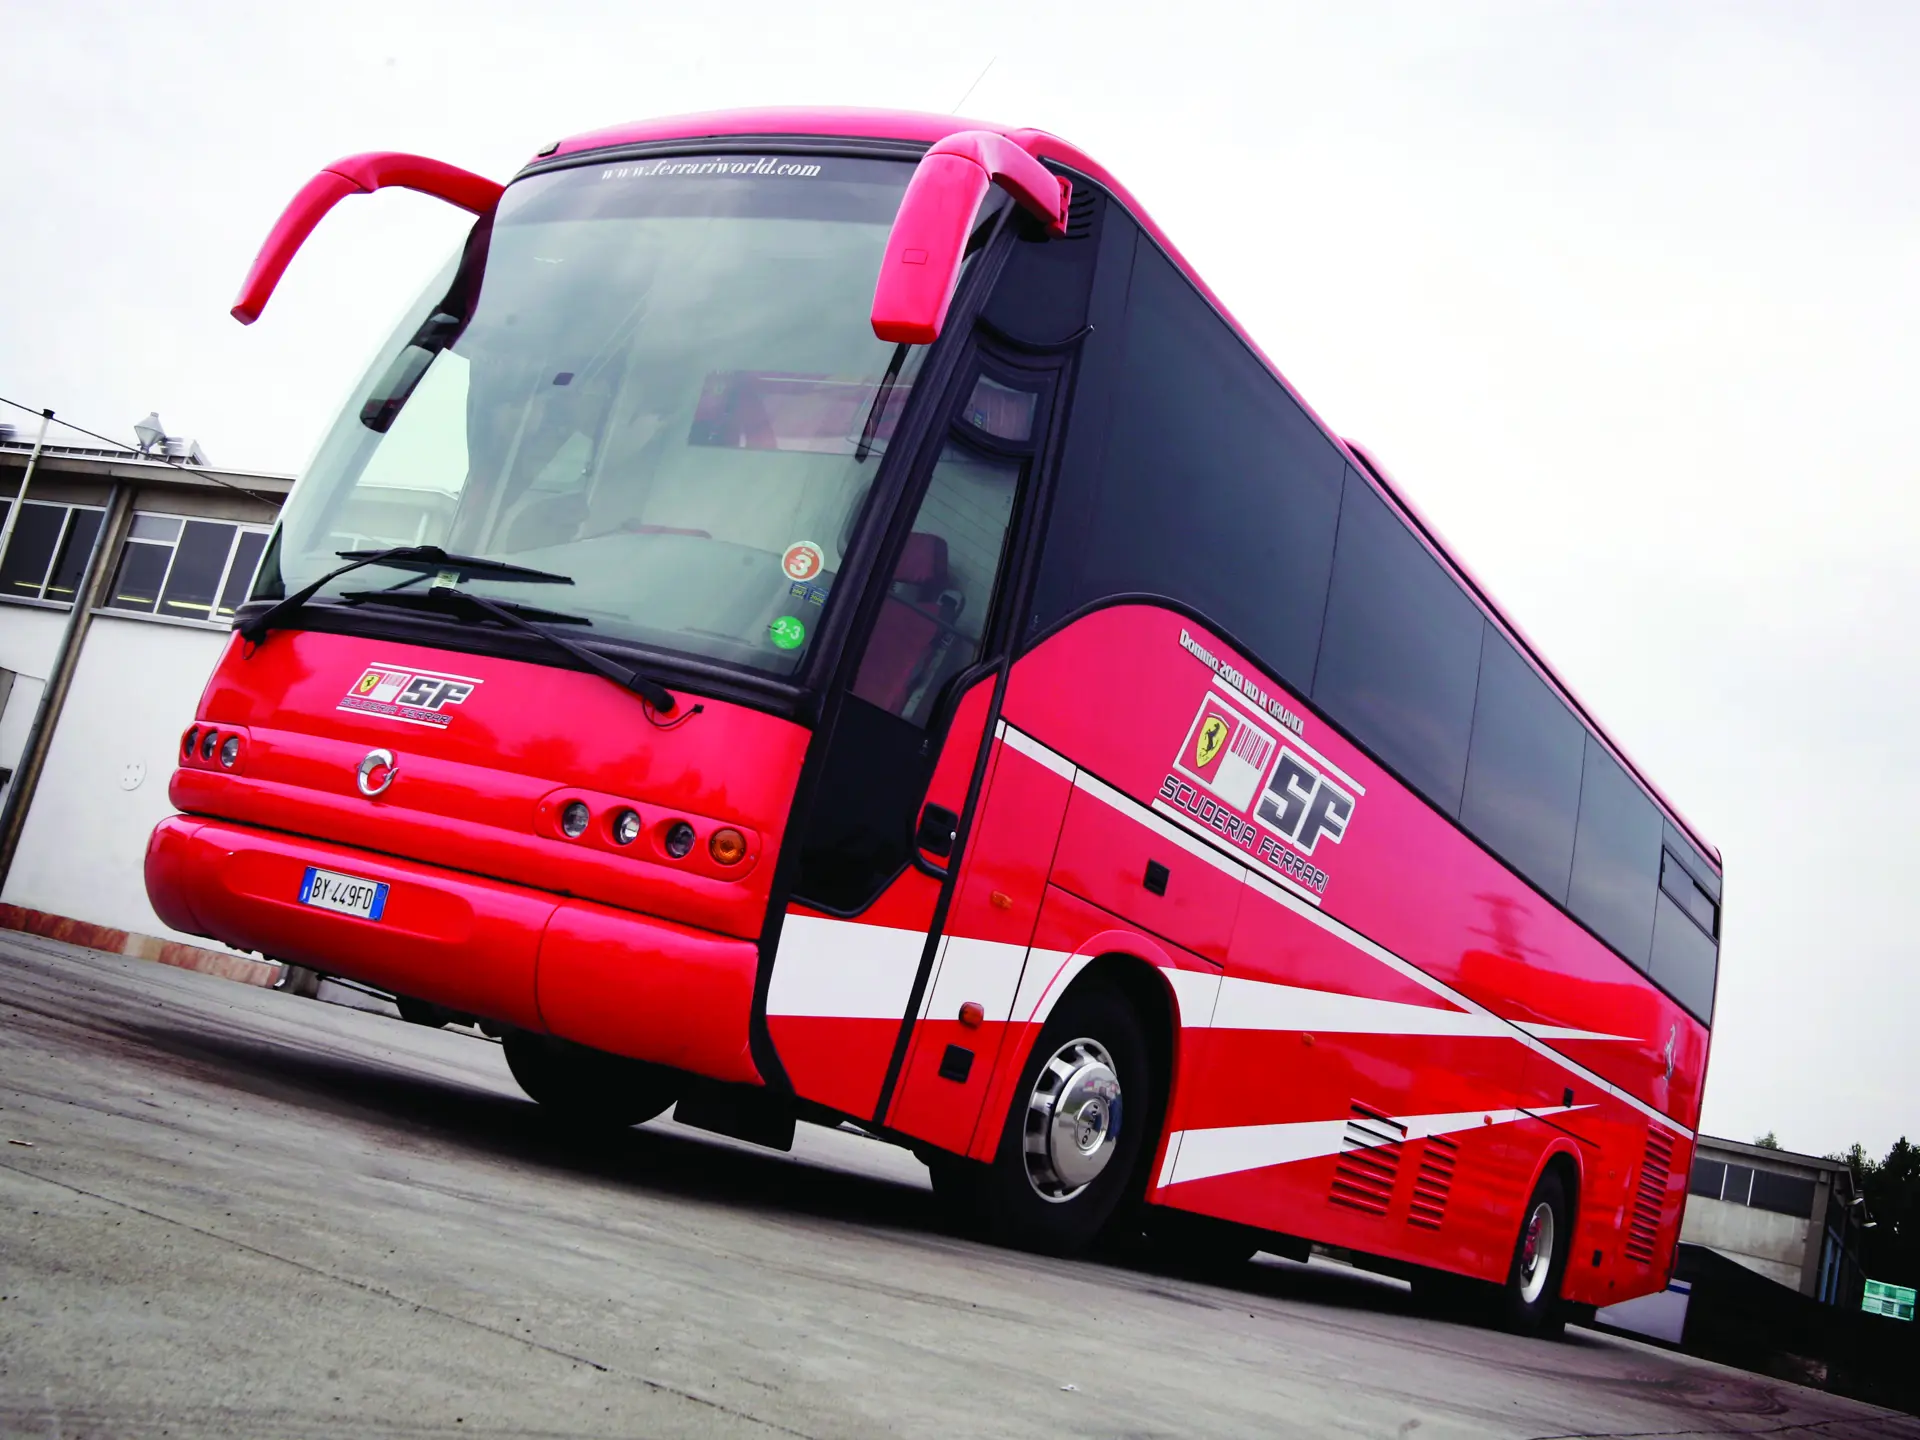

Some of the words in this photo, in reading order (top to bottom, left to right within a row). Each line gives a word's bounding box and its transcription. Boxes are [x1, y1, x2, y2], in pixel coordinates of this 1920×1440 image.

[602, 157, 821, 180] www.ferrariworld.com
[790, 554, 812, 575] 3
[777, 620, 801, 640] 2-3
[395, 675, 475, 711] SF
[1179, 628, 1219, 671] Domino
[1268, 698, 1304, 736] ORLANDI
[339, 697, 398, 714] SCUDERIA
[400, 708, 453, 724] FERRARI
[1253, 745, 1356, 857] SF
[1159, 774, 1257, 848] SCUDERIA
[1257, 837, 1330, 893] FERRARI
